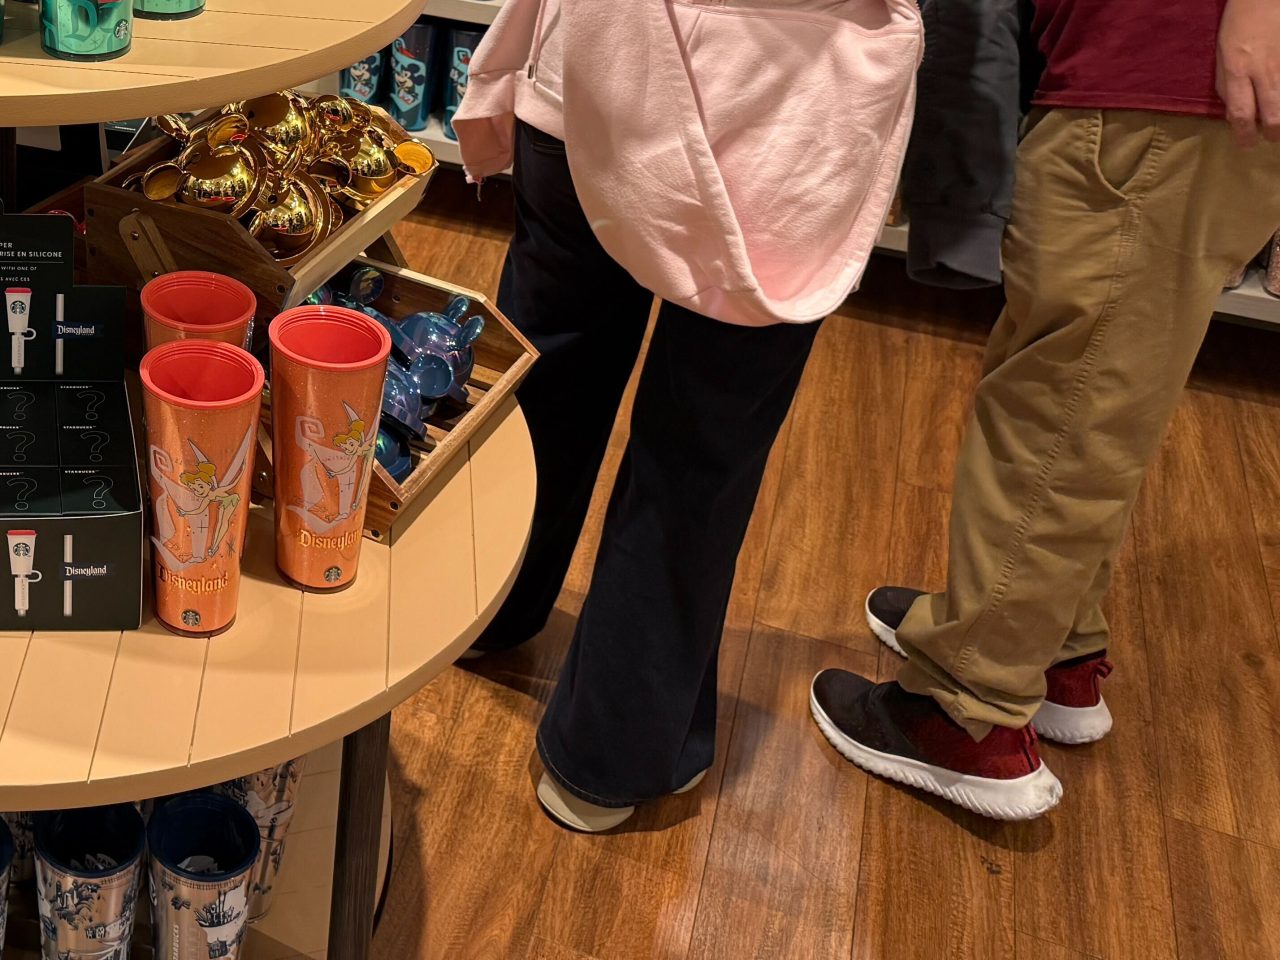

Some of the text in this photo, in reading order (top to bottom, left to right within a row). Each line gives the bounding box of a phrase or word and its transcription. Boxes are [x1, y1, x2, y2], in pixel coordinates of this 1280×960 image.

[56, 324, 95, 335] Disneyland
[64, 565, 106, 576] Disneyland
[156, 561, 228, 595] Disneyland
